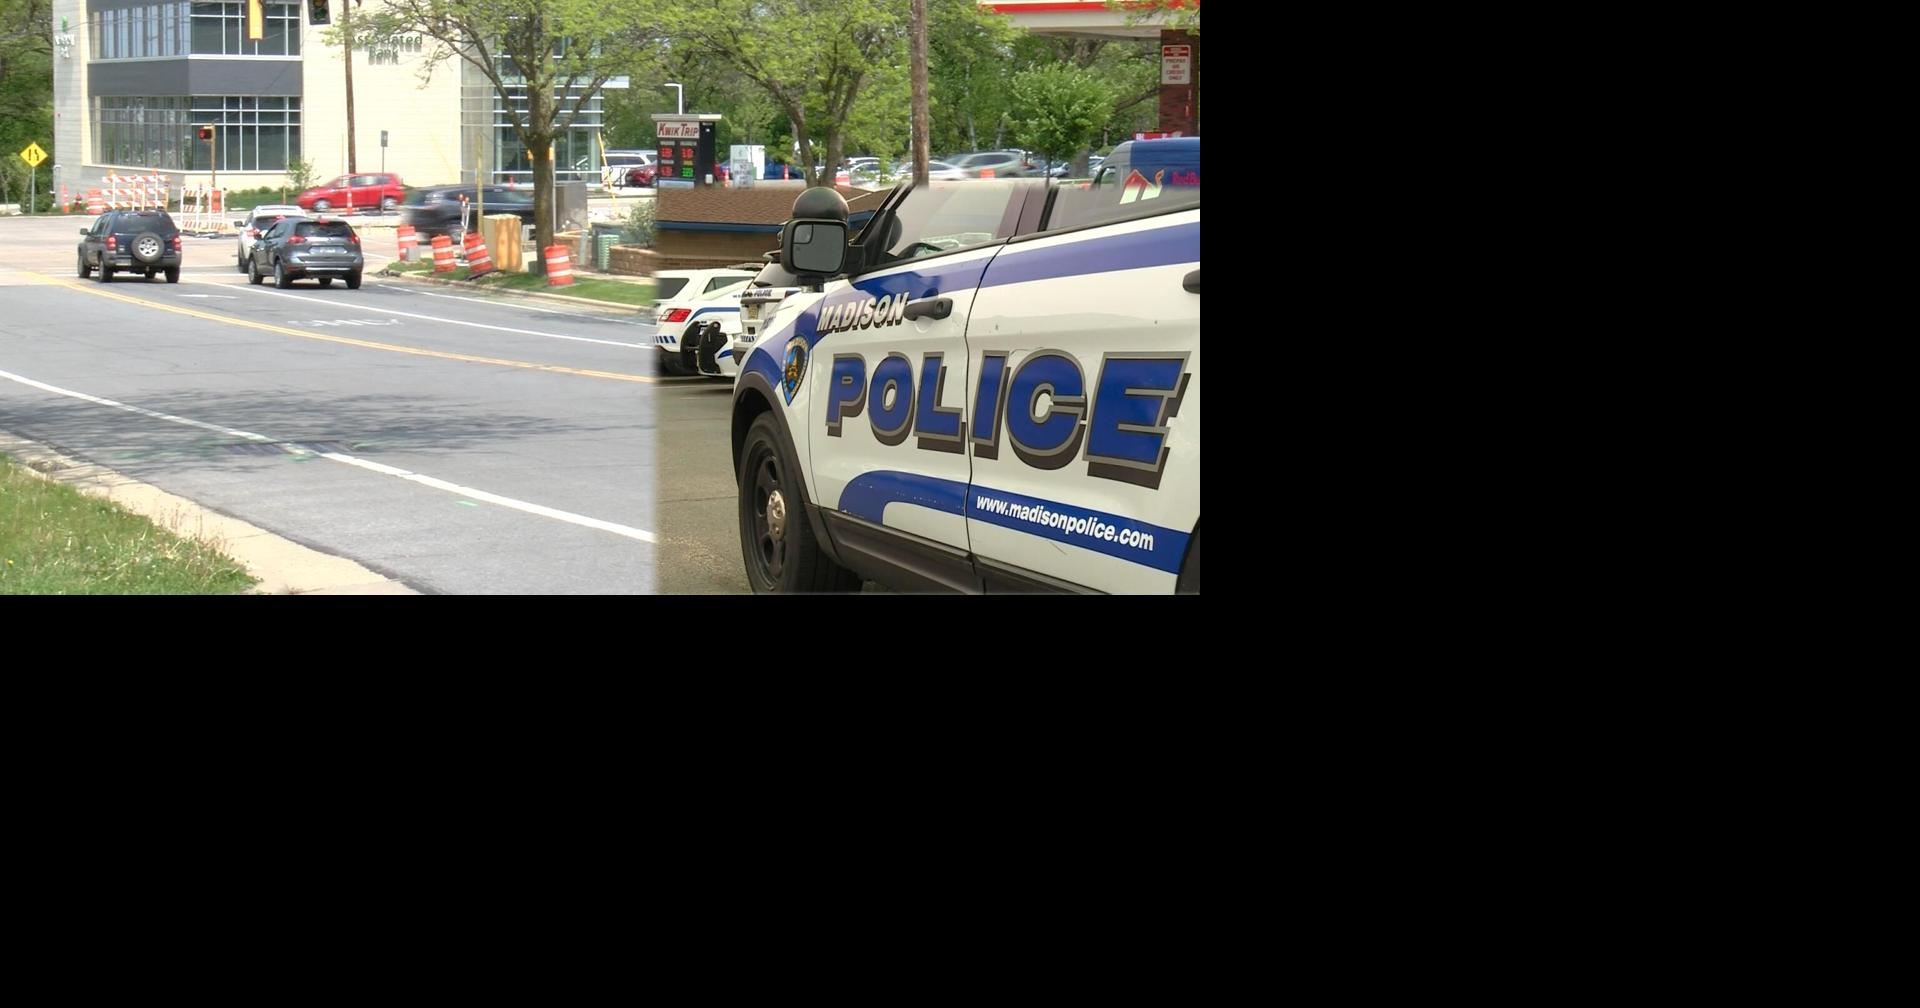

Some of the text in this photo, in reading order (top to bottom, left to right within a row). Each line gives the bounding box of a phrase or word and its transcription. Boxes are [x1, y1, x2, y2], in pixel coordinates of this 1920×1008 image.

[368, 45, 399, 59] Bank
[658, 123, 699, 136] KWIK TRIP
[816, 292, 910, 334] MADISON
[825, 348, 1192, 490] POLICE
[975, 495, 1154, 551] www.madisonpolice.com
